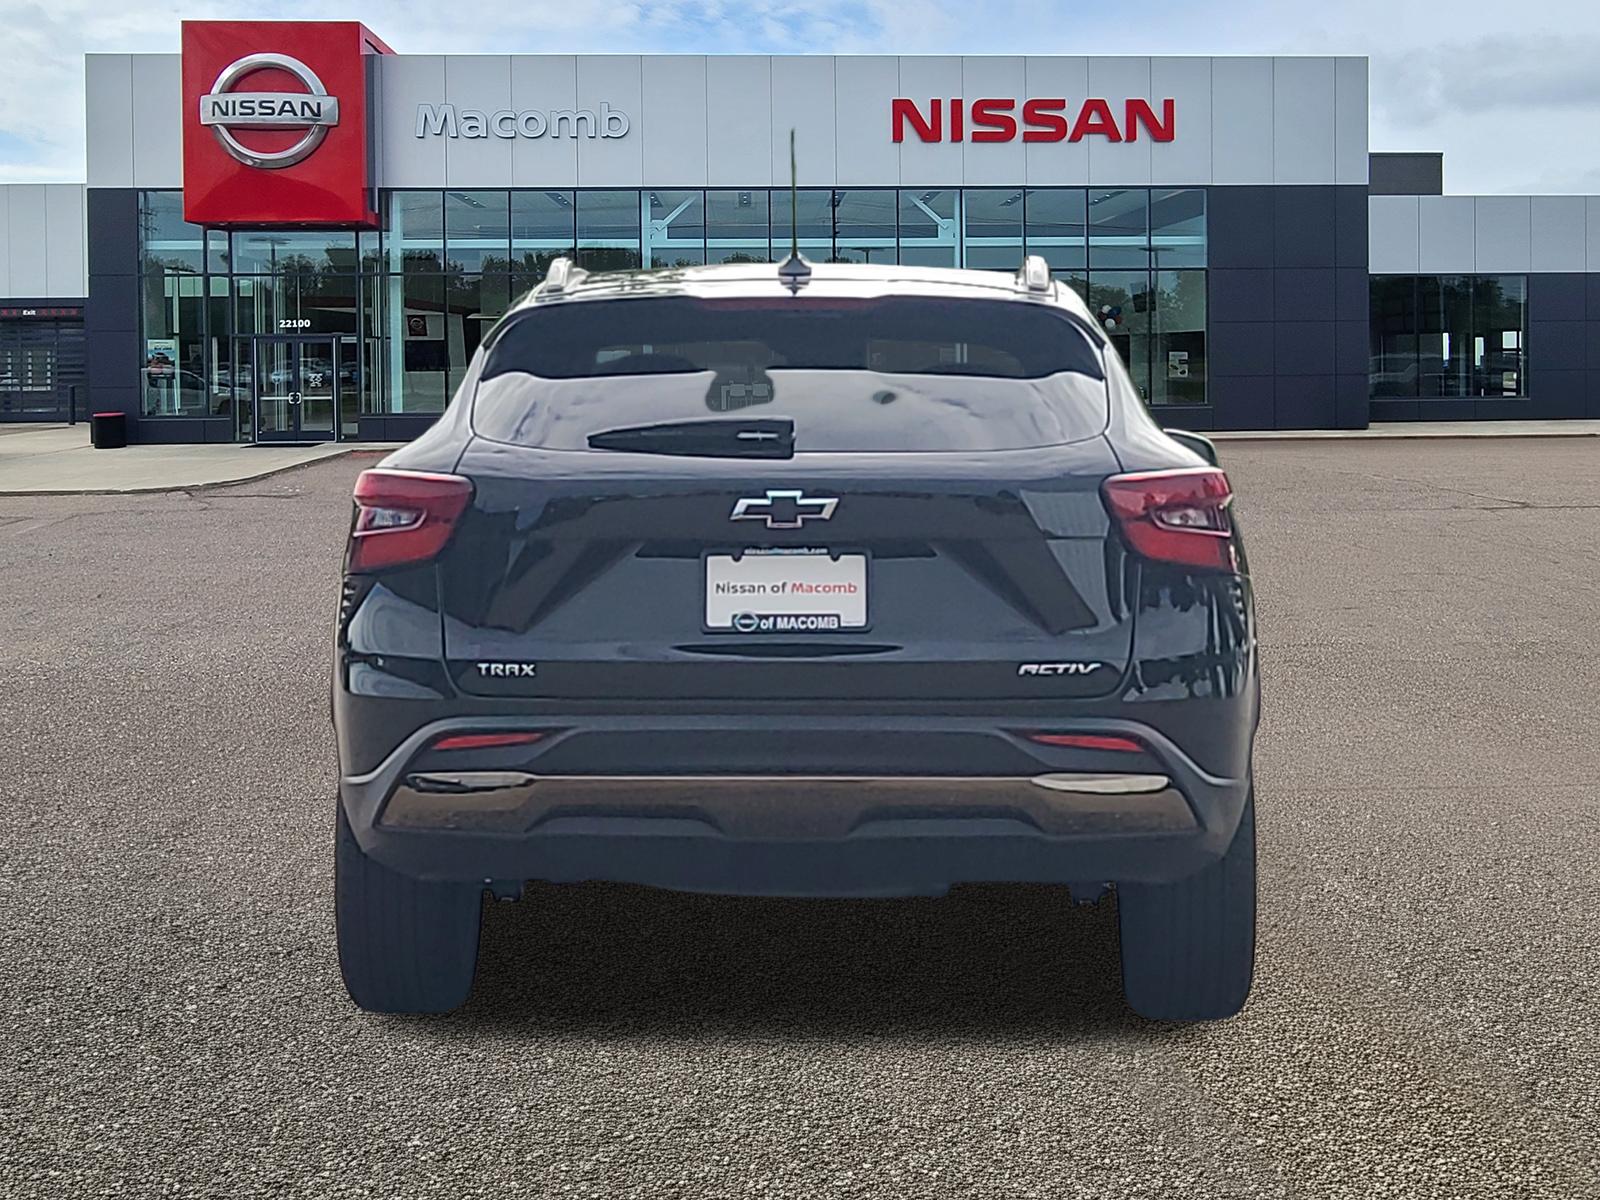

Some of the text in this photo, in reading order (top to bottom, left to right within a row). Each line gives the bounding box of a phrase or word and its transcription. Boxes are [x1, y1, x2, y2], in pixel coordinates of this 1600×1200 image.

[211, 100, 321, 118] NISSAN
[415, 101, 631, 139] Macomb
[890, 98, 1176, 143] NISSAN
[279, 319, 311, 328] 22100
[715, 582, 858, 594] Nissan of Macomb
[760, 616, 839, 630] of MACOMB
[477, 662, 536, 676] TRAX
[1017, 662, 1102, 675] ACTIV
